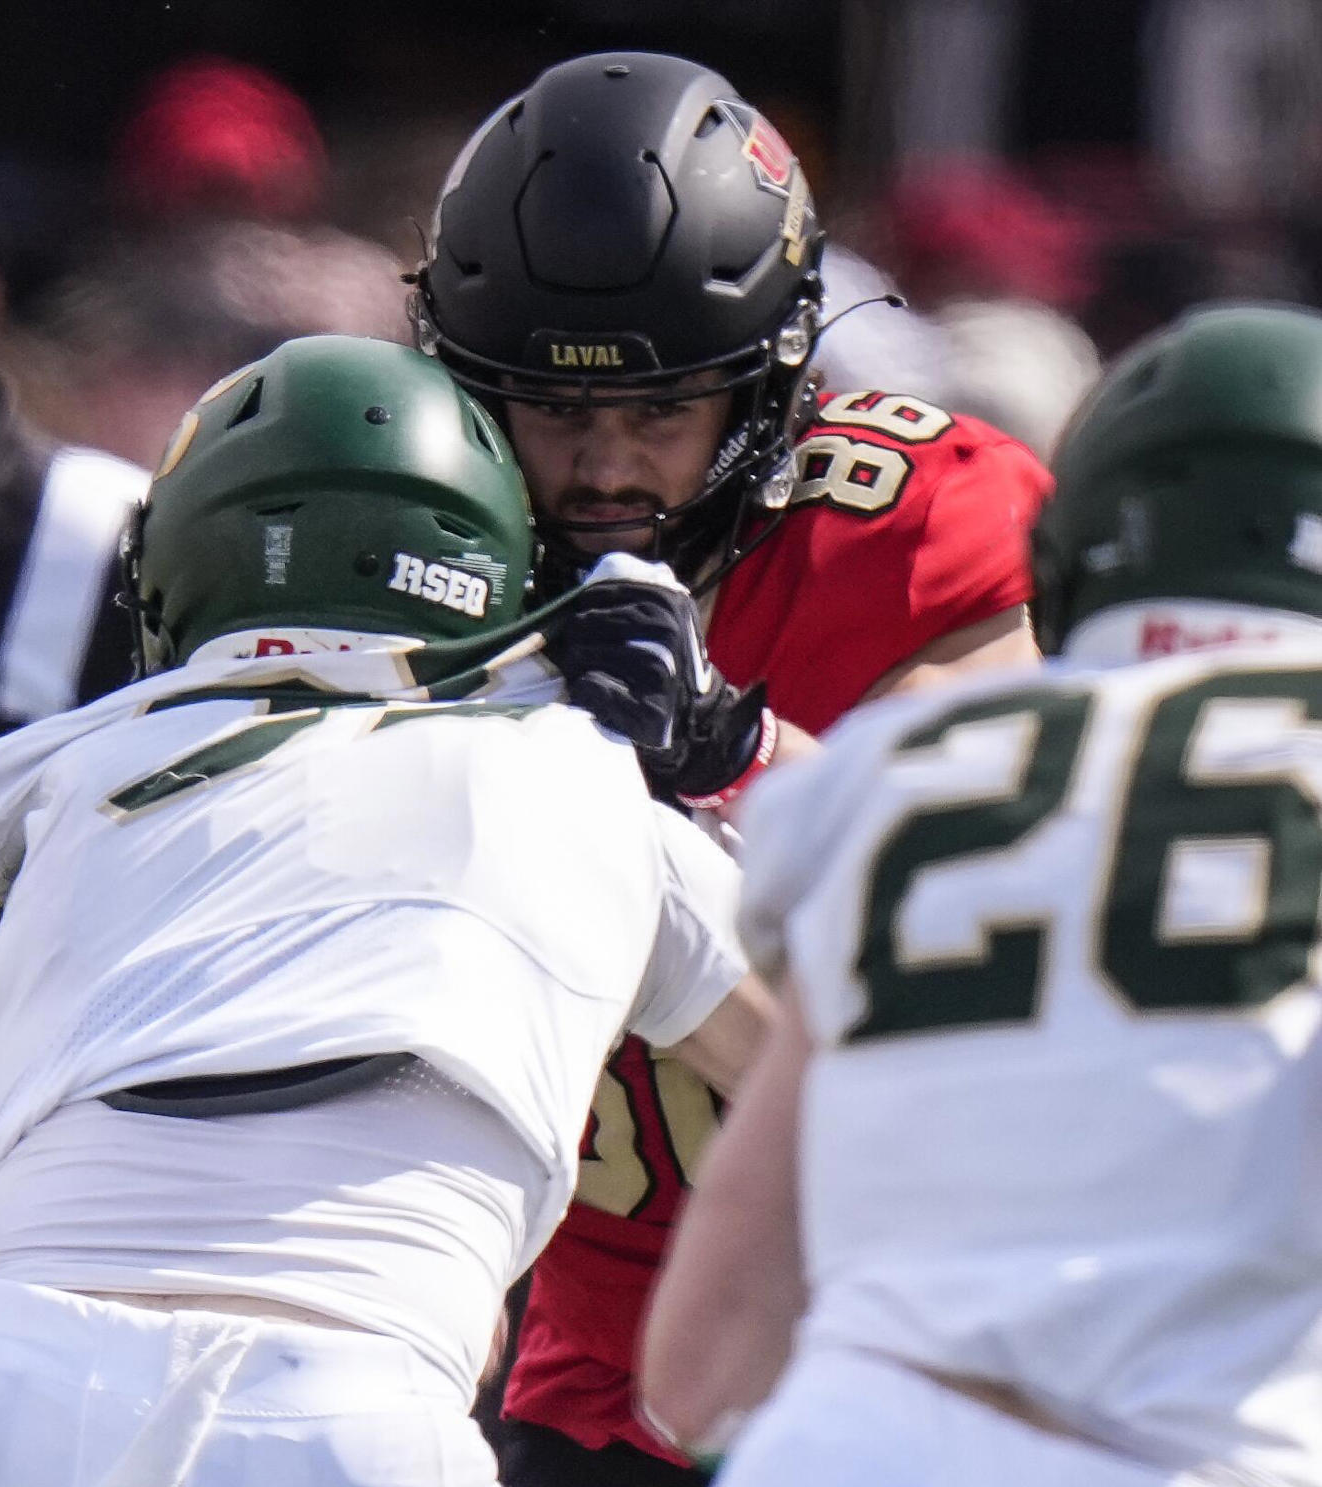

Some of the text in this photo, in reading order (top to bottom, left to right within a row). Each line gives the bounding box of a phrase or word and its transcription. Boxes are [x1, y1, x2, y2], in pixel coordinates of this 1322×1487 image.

[550, 344, 624, 367] LAVAL
[785, 390, 956, 516] 86
[387, 552, 489, 618] RSEQ
[839, 669, 1322, 1047] 26
